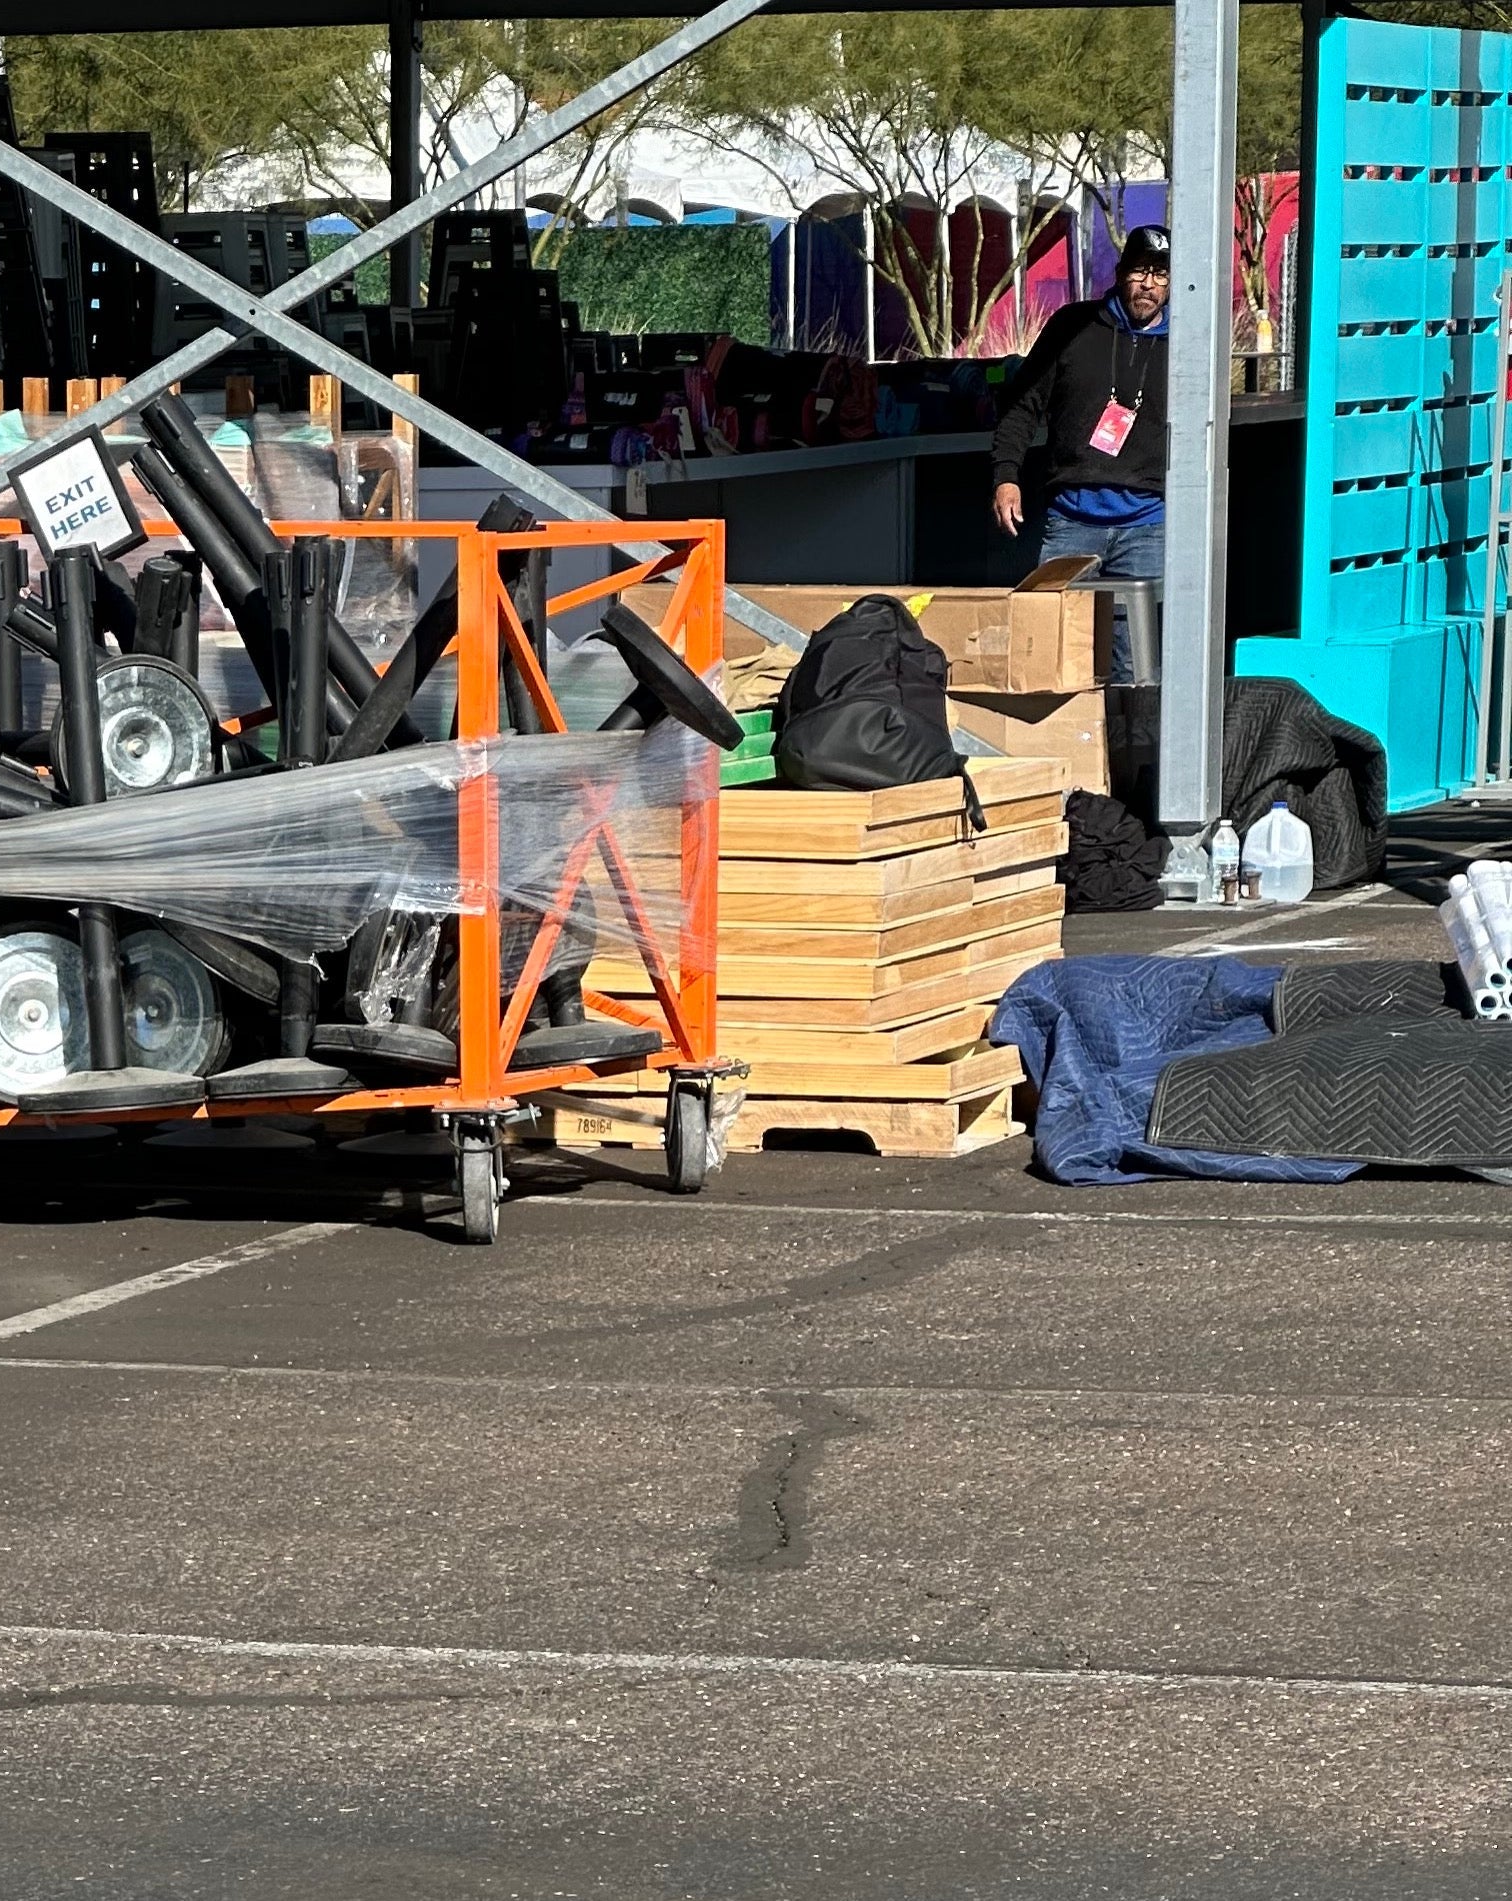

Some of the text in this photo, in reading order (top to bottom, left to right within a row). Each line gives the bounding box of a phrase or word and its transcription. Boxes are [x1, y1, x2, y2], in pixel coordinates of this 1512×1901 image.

[44, 475, 95, 514] EXIT
[50, 496, 113, 540] HERE
[577, 1117, 612, 1133] 789164
